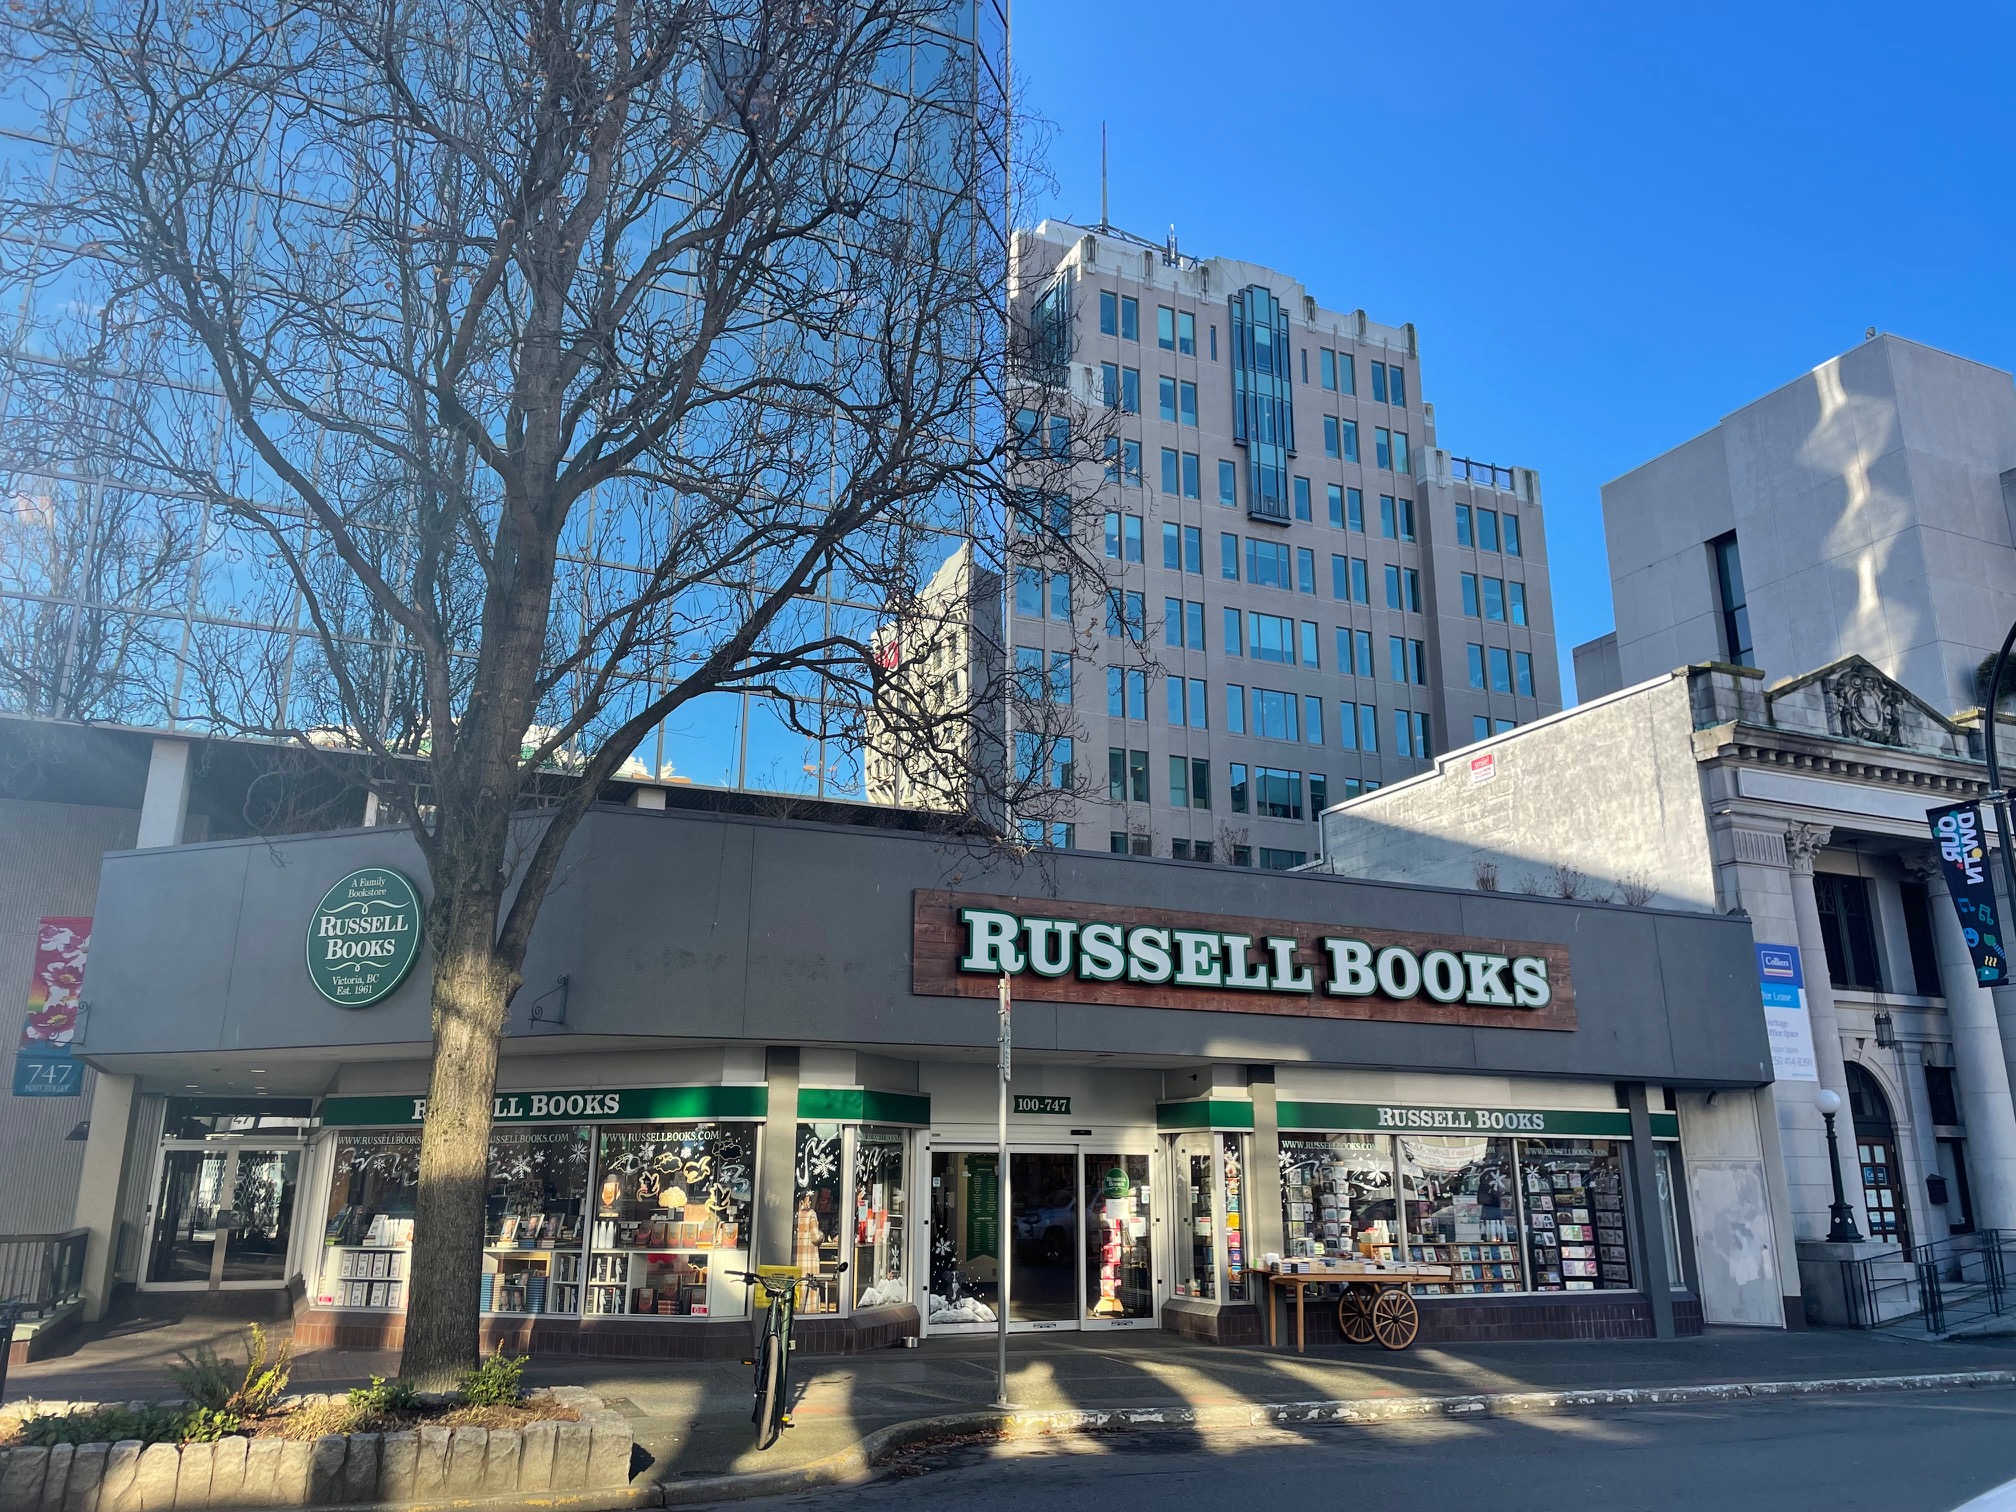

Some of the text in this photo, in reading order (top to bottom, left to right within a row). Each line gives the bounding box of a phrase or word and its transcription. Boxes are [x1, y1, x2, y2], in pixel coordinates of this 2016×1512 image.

[351, 877, 386, 888] A Family
[348, 888, 387, 898] Bookstore
[318, 914, 409, 937] RUSSELL
[325, 938, 396, 960] BOOKS
[961, 907, 1315, 994] RUSSELL
[1324, 936, 1552, 1009] BOOKS
[1765, 956, 1790, 967] Colliers
[332, 973, 380, 986] Victoria, BC
[336, 985, 373, 995] Est. 1961
[1773, 992, 1792, 1001] Lease
[1783, 1030, 1799, 1039] Space
[1772, 1056, 1784, 1066] 50
[27, 1064, 73, 1084] 747
[529, 1093, 620, 1116] BOOKS
[1017, 1098, 1067, 1112] 100-747
[1377, 1107, 1545, 1130] RUSSELL BOOKS
[338, 1134, 422, 1145] WWW.RUSSELLBOOKS
[490, 1133, 570, 1144] USSELLBOOKS.COM
[601, 1130, 719, 1142] WWW.RUSSELLBOOKS.COM
